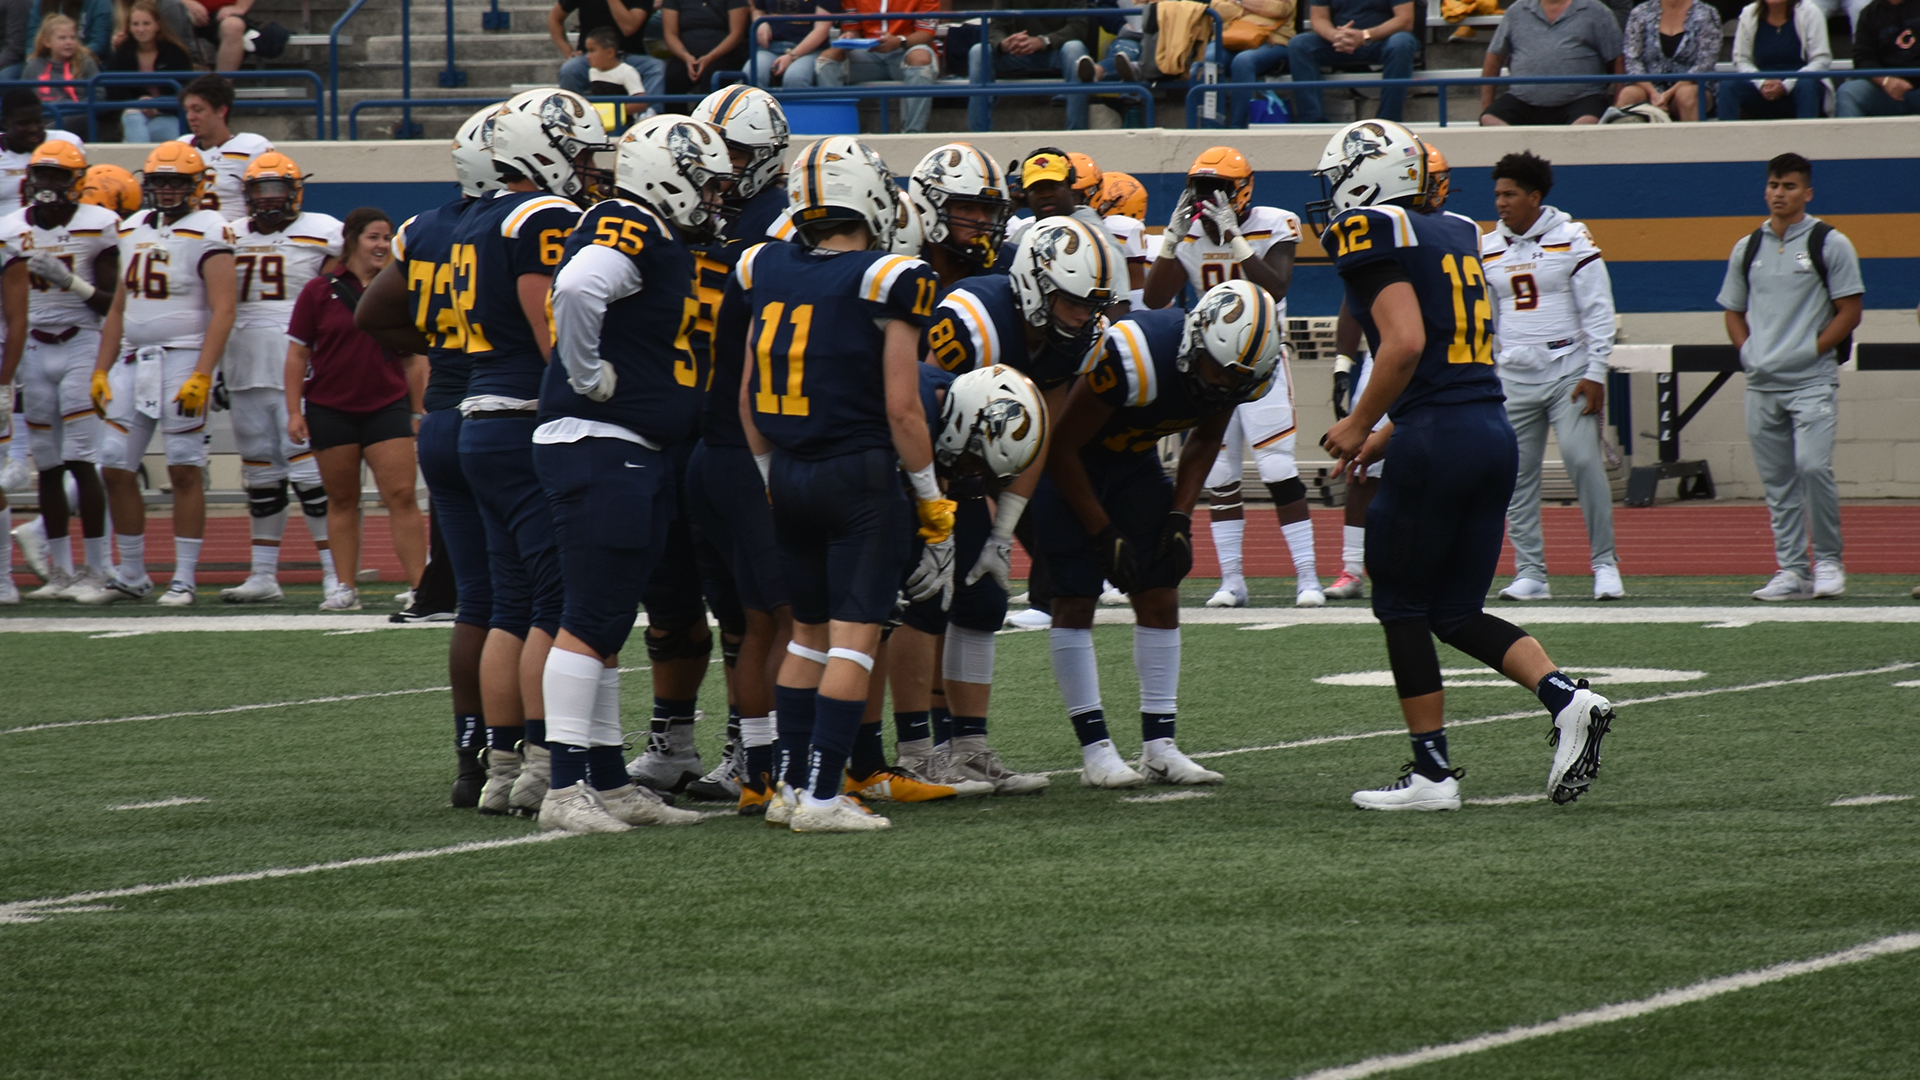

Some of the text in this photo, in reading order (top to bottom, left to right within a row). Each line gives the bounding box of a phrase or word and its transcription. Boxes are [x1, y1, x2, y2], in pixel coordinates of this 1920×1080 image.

[539, 227, 574, 266] 6
[592, 216, 649, 256] 55
[1329, 215, 1373, 258] 12
[125, 252, 170, 300] 46
[236, 254, 286, 301] 79
[911, 277, 936, 317] 11
[1510, 272, 1538, 312] 9
[1441, 253, 1494, 366] 12
[755, 301, 814, 416] 11
[928, 317, 967, 371] 80
[1658, 373, 1671, 441] GILL
